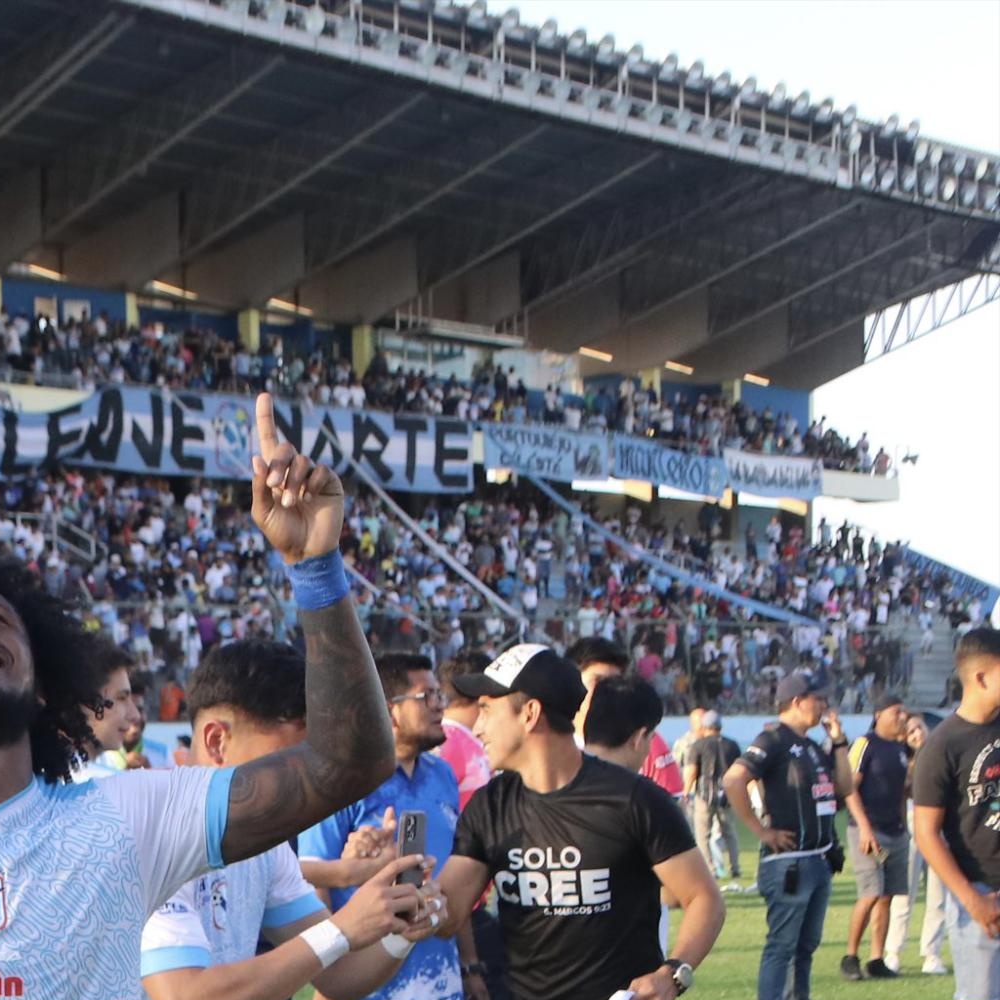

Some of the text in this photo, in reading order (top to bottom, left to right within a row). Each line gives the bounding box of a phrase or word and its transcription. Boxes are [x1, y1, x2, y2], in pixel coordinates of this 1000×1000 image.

[508, 846, 582, 870] SOLO
[494, 867, 612, 906] CREE
[554, 905, 593, 916] MARCOS
